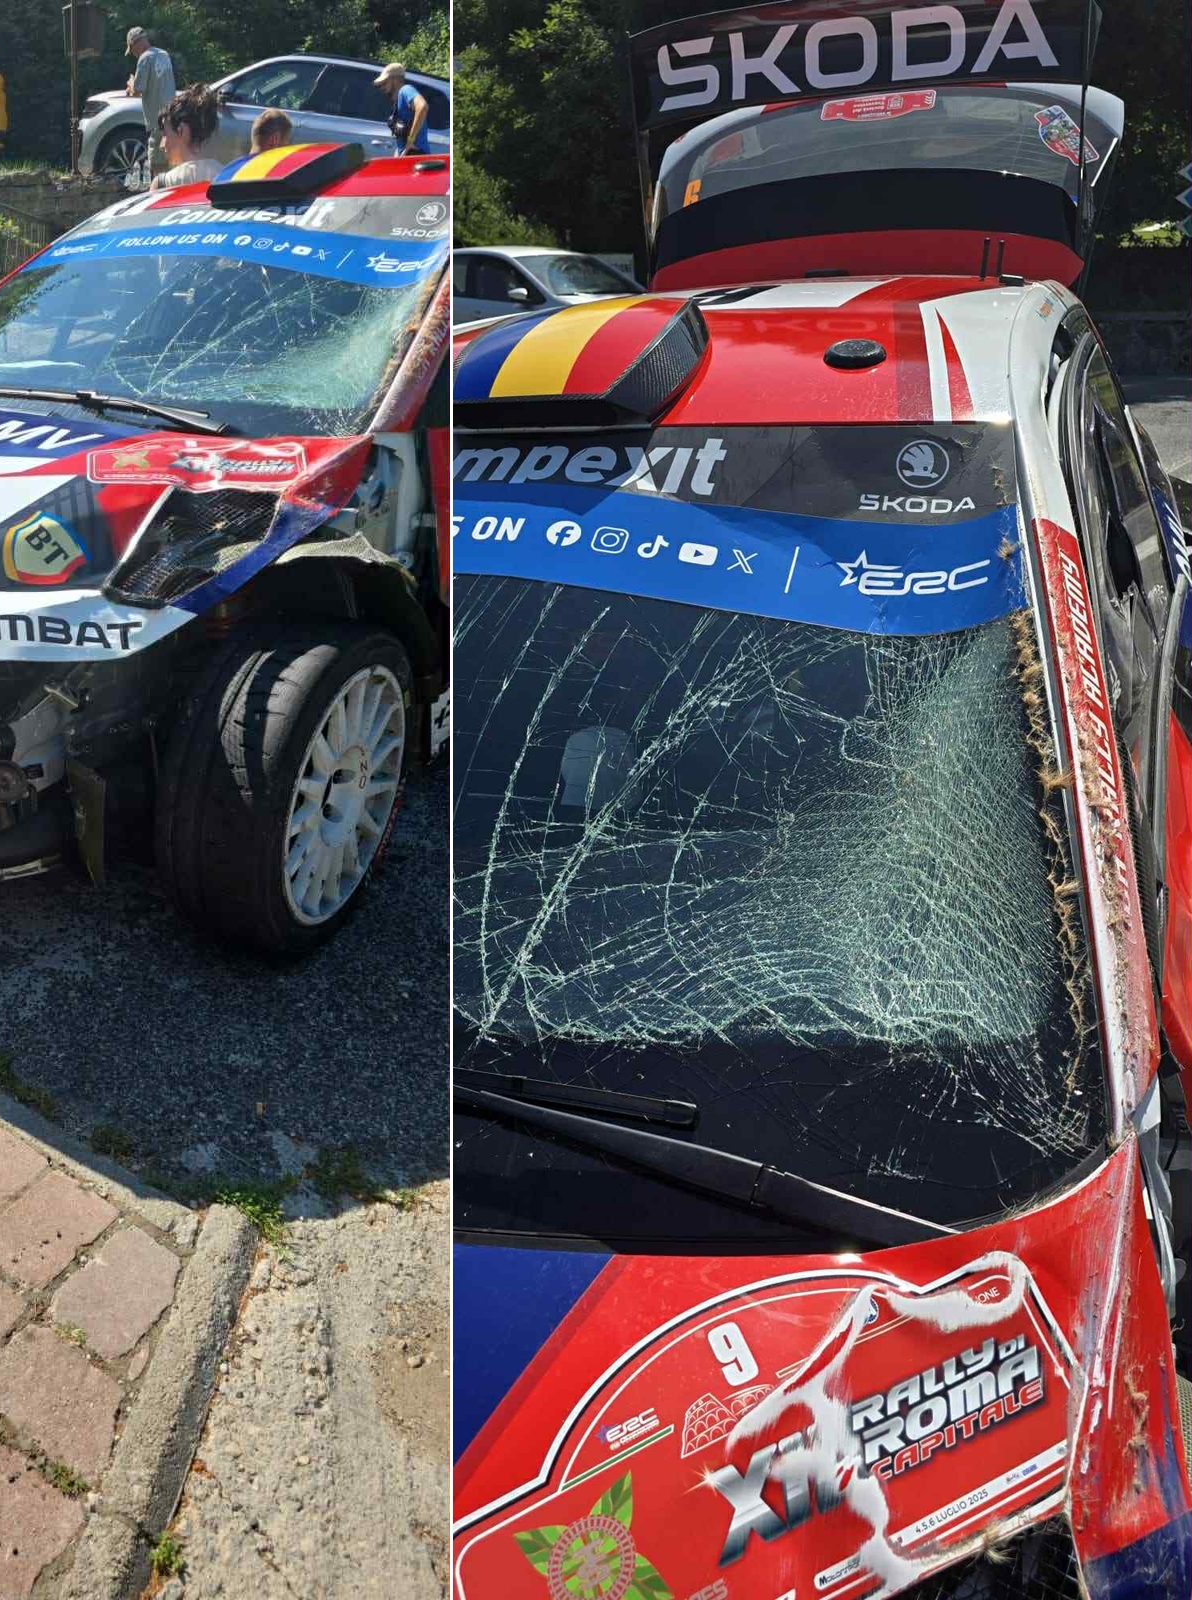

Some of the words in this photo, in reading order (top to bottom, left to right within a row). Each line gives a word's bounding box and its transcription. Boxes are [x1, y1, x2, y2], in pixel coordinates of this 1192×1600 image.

[116, 234, 177, 248] FOLLOW
[176, 233, 202, 245] US
[201, 233, 229, 244] ON
[471, 516, 526, 542] ON
[858, 493, 977, 514] SKODA
[24, 524, 70, 565] BT
[1060, 548, 1105, 710] ACADEMY
[707, 1321, 760, 1387] 9
[851, 1337, 996, 1431] RALLY
[998, 1333, 1027, 1361] DI
[861, 1345, 1041, 1465] ROMA
[870, 1377, 1046, 1482] CAPITALE
[915, 1517, 936, 1534] 4.5.6
[935, 1500, 967, 1523] LUGLIO
[967, 1487, 989, 1506] 2025
